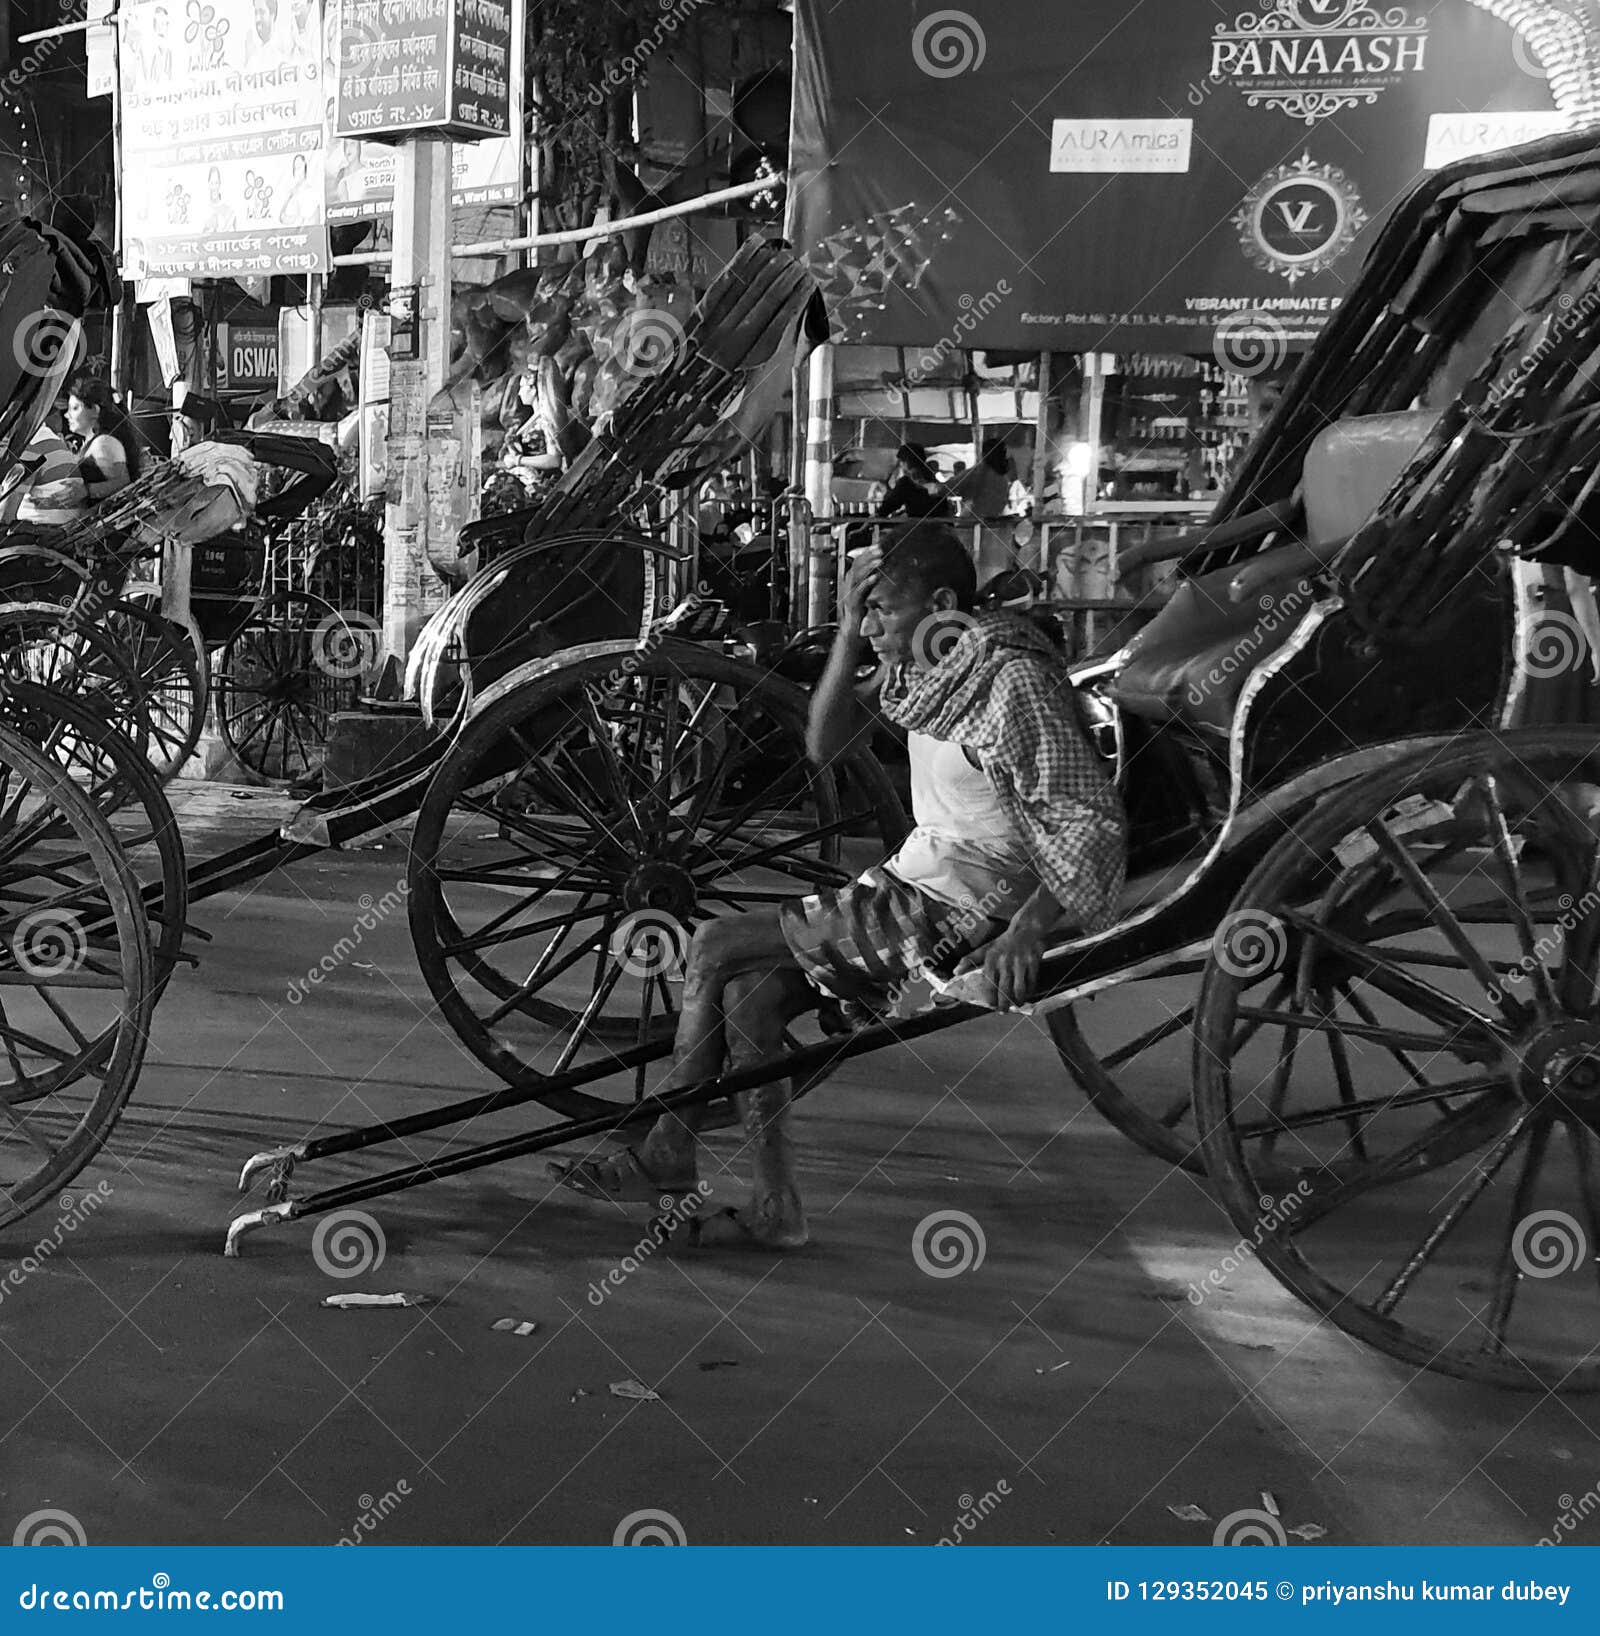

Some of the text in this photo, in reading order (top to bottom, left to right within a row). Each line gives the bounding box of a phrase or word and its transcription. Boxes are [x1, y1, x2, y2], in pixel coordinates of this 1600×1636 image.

[1209, 36, 1428, 75] PANAASH
[225, 61, 298, 92] দীপাবলি
[305, 63, 318, 80] ও
[216, 99, 298, 126] অভিনন্দন
[348, 103, 383, 127] ওয়ার্ড
[203, 234, 263, 253] ওয়ার্ডের
[1185, 297, 1250, 311] VIBRANT
[1253, 297, 1327, 311] LAMINATE
[234, 347, 278, 378] OSWA
